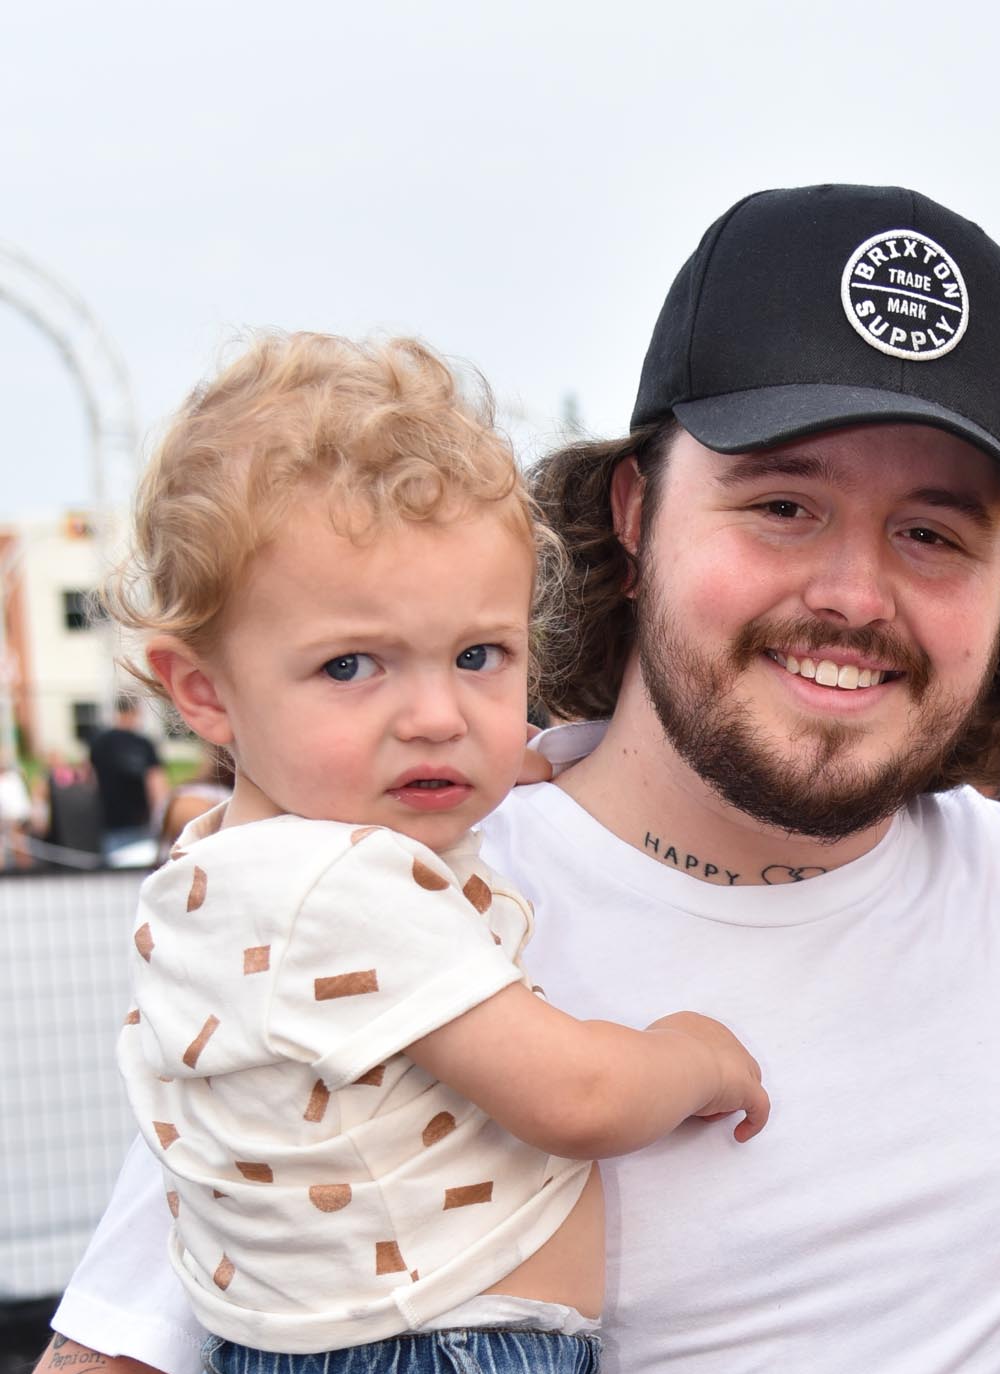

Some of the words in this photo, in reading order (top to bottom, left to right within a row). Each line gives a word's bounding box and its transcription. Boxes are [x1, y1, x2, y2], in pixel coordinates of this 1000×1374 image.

[854, 239, 961, 298] BRIXTON
[888, 268, 932, 292] TRADE
[855, 300, 955, 351] SUPPLY
[887, 297, 928, 320] MARK
[644, 831, 741, 885] HAPPY
